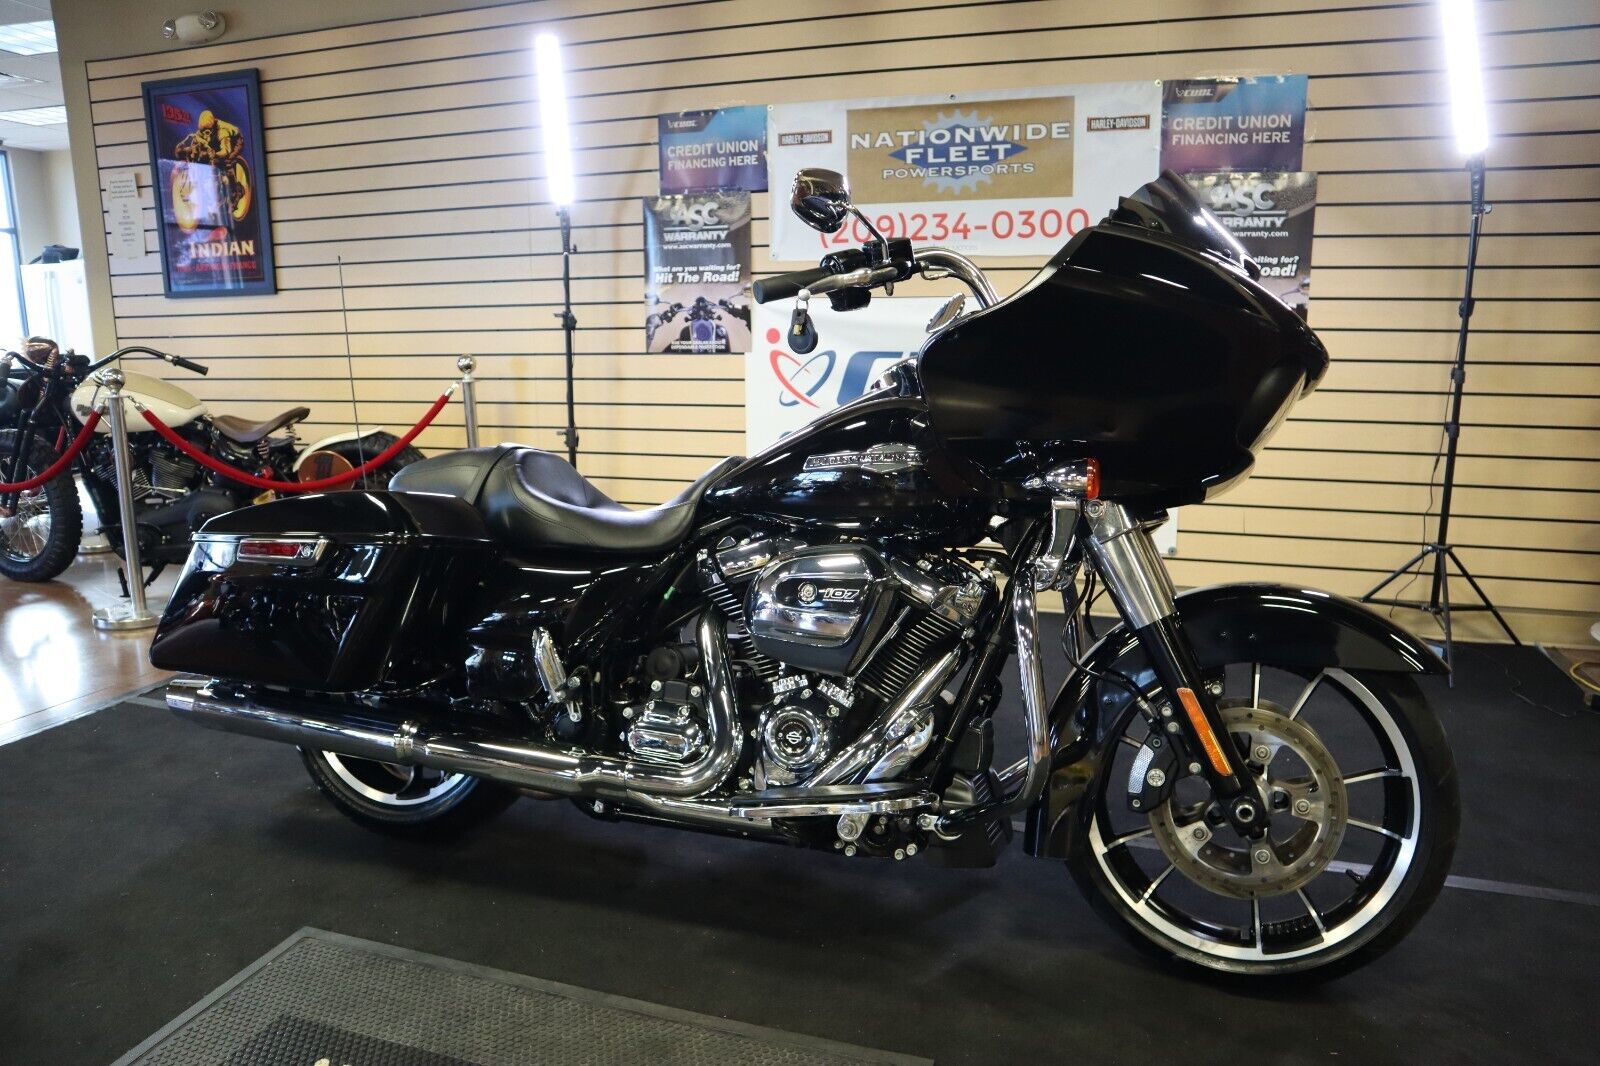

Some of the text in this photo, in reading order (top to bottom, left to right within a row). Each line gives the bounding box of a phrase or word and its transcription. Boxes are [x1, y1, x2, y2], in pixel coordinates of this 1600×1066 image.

[1090, 116, 1146, 130] HARLEY-DAVIDSON
[1172, 114, 1292, 131] CREDIT UNION
[851, 122, 1071, 149] NATIONWIDE
[1172, 131, 1291, 146] FINANCING HERE
[667, 140, 760, 158] CREDIT UNION
[905, 143, 1012, 164] FLEET
[667, 154, 759, 171] FINANCING HERE
[883, 162, 1035, 179] POWERSPORTS
[1210, 182, 1276, 217] ASC
[670, 201, 720, 231] ASC
[663, 229, 729, 242] WARRANTY
[819, 207, 1090, 249] (209)234-0300
[188, 239, 256, 259] INDIAN
[684, 266, 698, 274] you
[699, 264, 725, 272] waiting
[726, 263, 742, 271] for?
[1253, 255, 1299, 265] aiting for?
[655, 271, 740, 284] Hit The Road!
[1260, 263, 1298, 277] oad!
[819, 588, 860, 600] 107
